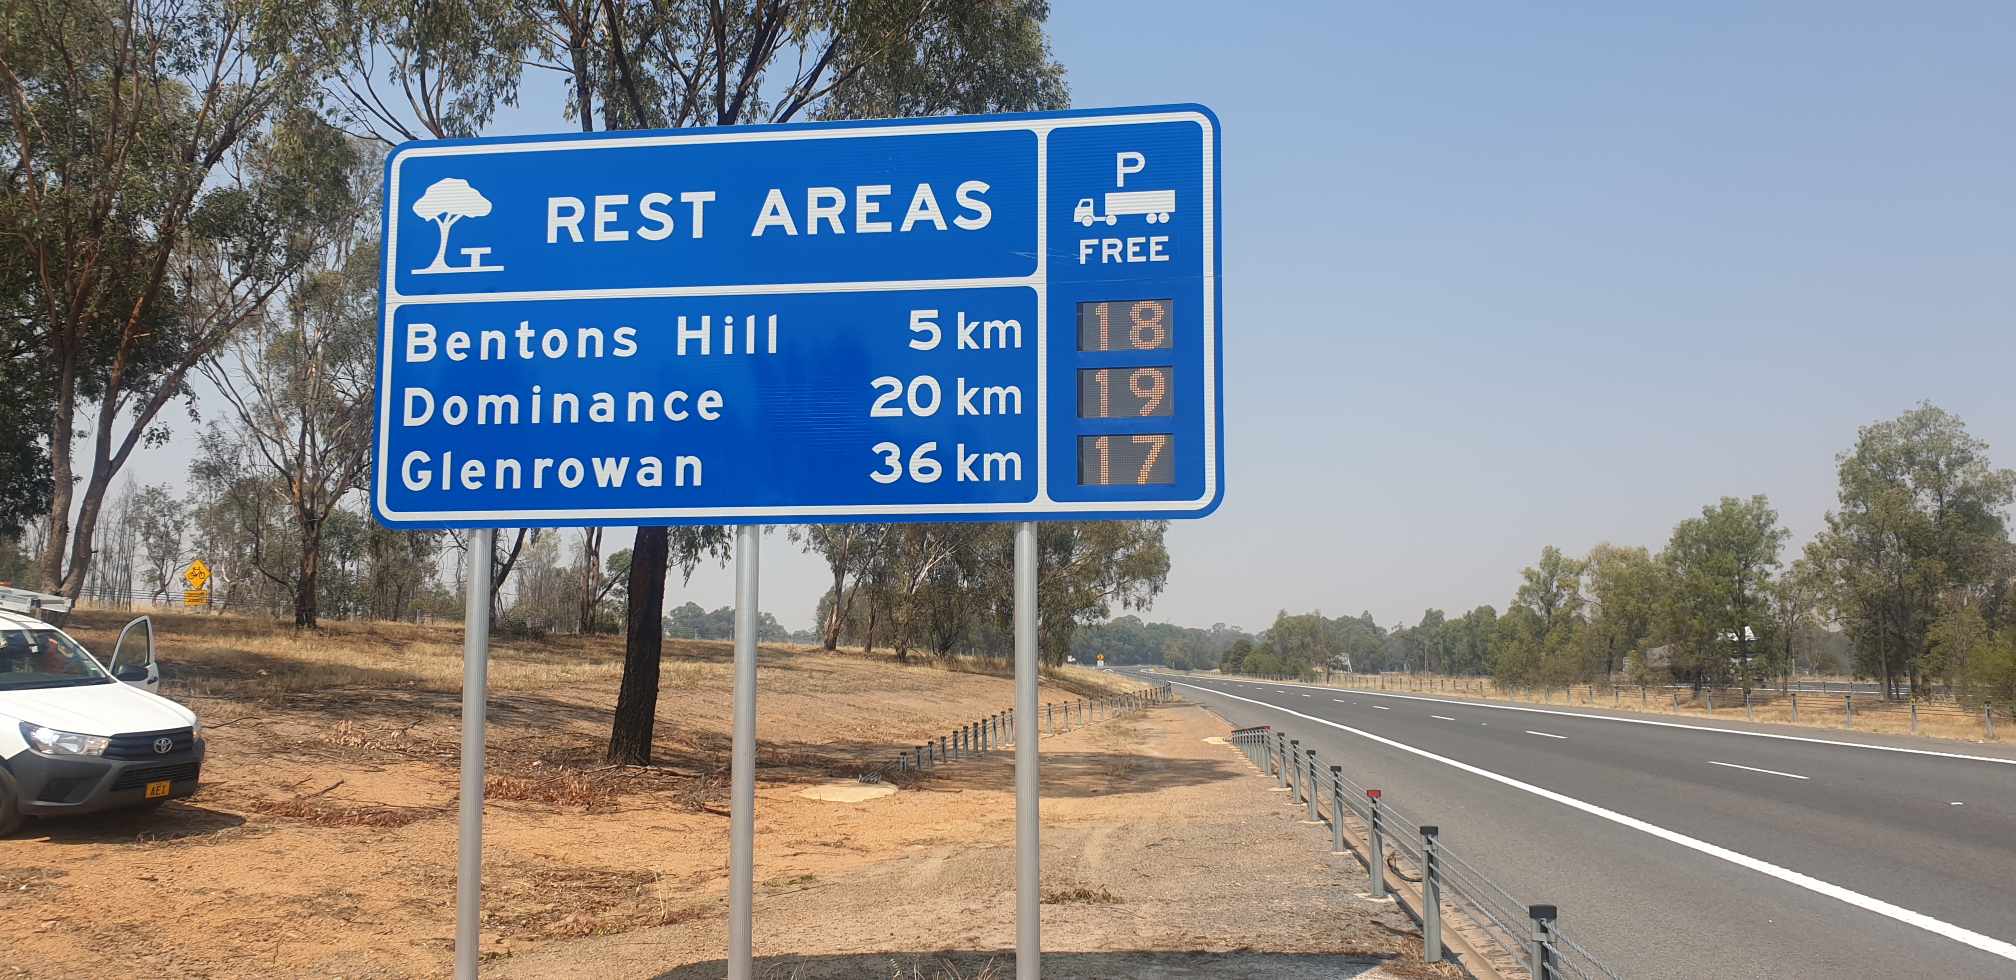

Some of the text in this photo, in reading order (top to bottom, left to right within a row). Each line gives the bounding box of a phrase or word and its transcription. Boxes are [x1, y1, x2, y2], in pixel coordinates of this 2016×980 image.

[1116, 151, 1146, 188] P
[547, 181, 992, 244] REST AREAS
[1079, 235, 1170, 265] FREE
[406, 309, 1022, 363] Bentons Hill 5 km
[1095, 301, 1164, 350] 18
[403, 375, 1022, 427] Dominance 20 km
[1095, 367, 1164, 417] 19
[401, 441, 1022, 492] Glenrowan 36 km
[1095, 434, 1165, 484] 17
